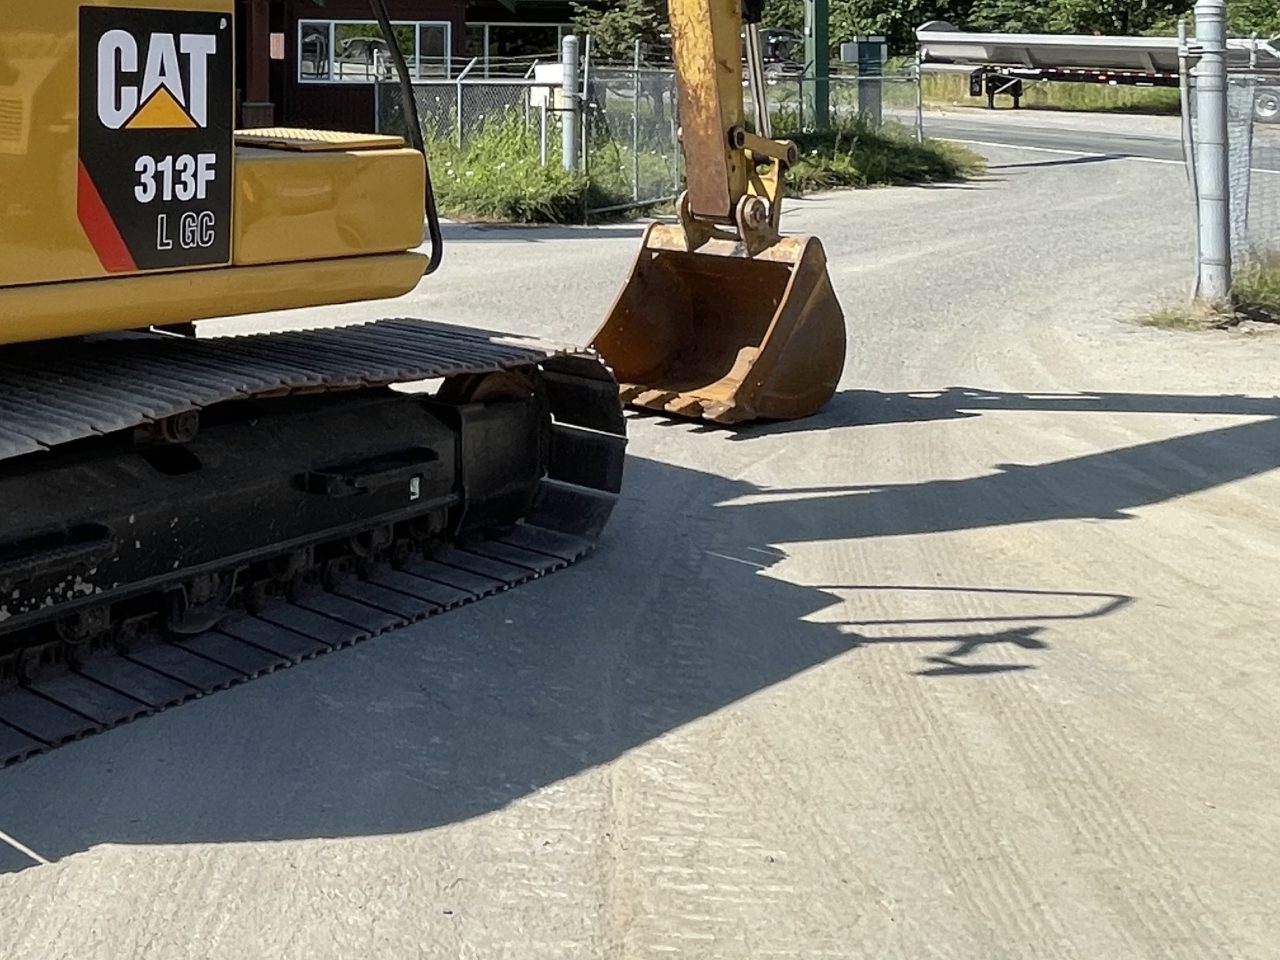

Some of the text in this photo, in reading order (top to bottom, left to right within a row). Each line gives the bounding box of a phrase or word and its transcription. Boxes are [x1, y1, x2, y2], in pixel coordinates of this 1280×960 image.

[97, 29, 217, 130] CAT
[134, 153, 216, 203] 313F
[157, 210, 216, 250] L GC
